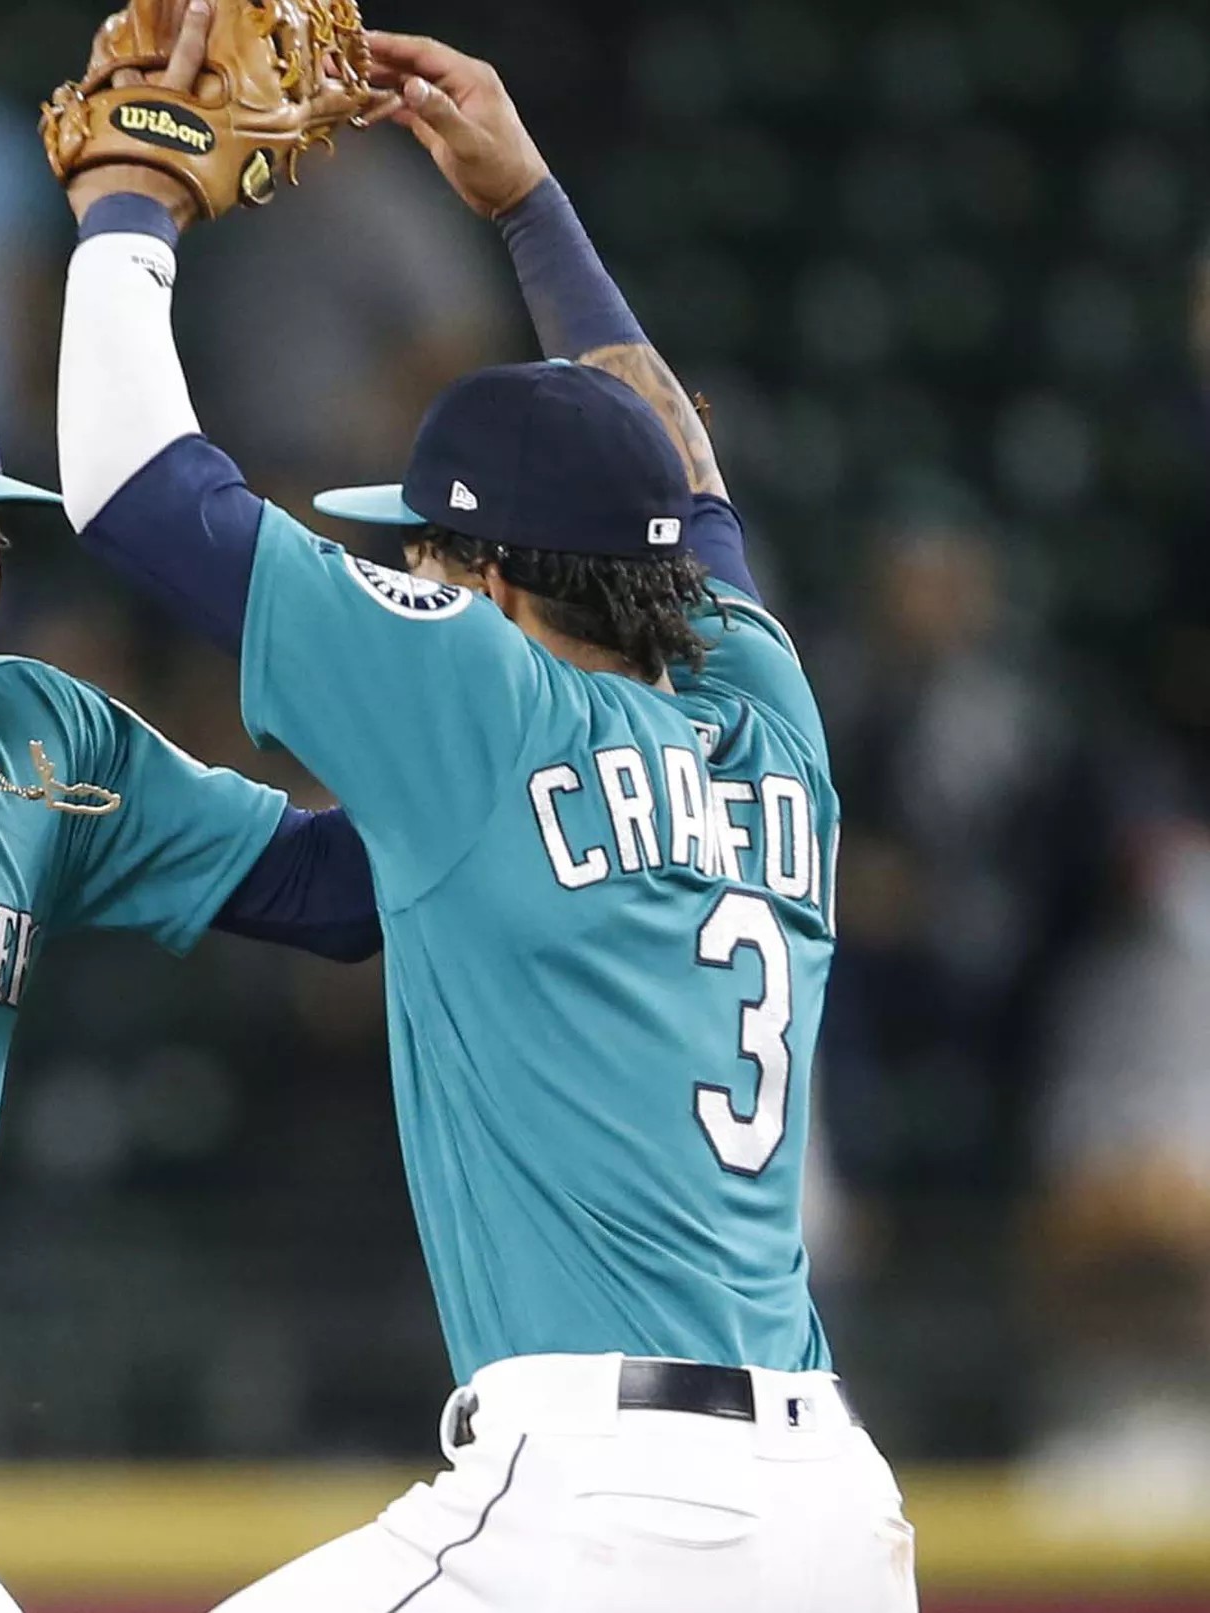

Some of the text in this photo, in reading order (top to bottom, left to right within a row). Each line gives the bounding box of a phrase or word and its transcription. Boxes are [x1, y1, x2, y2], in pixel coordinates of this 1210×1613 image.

[119, 105, 207, 151] Wilson
[528, 745, 840, 940] CRAFO
[693, 888, 791, 1178] 3
